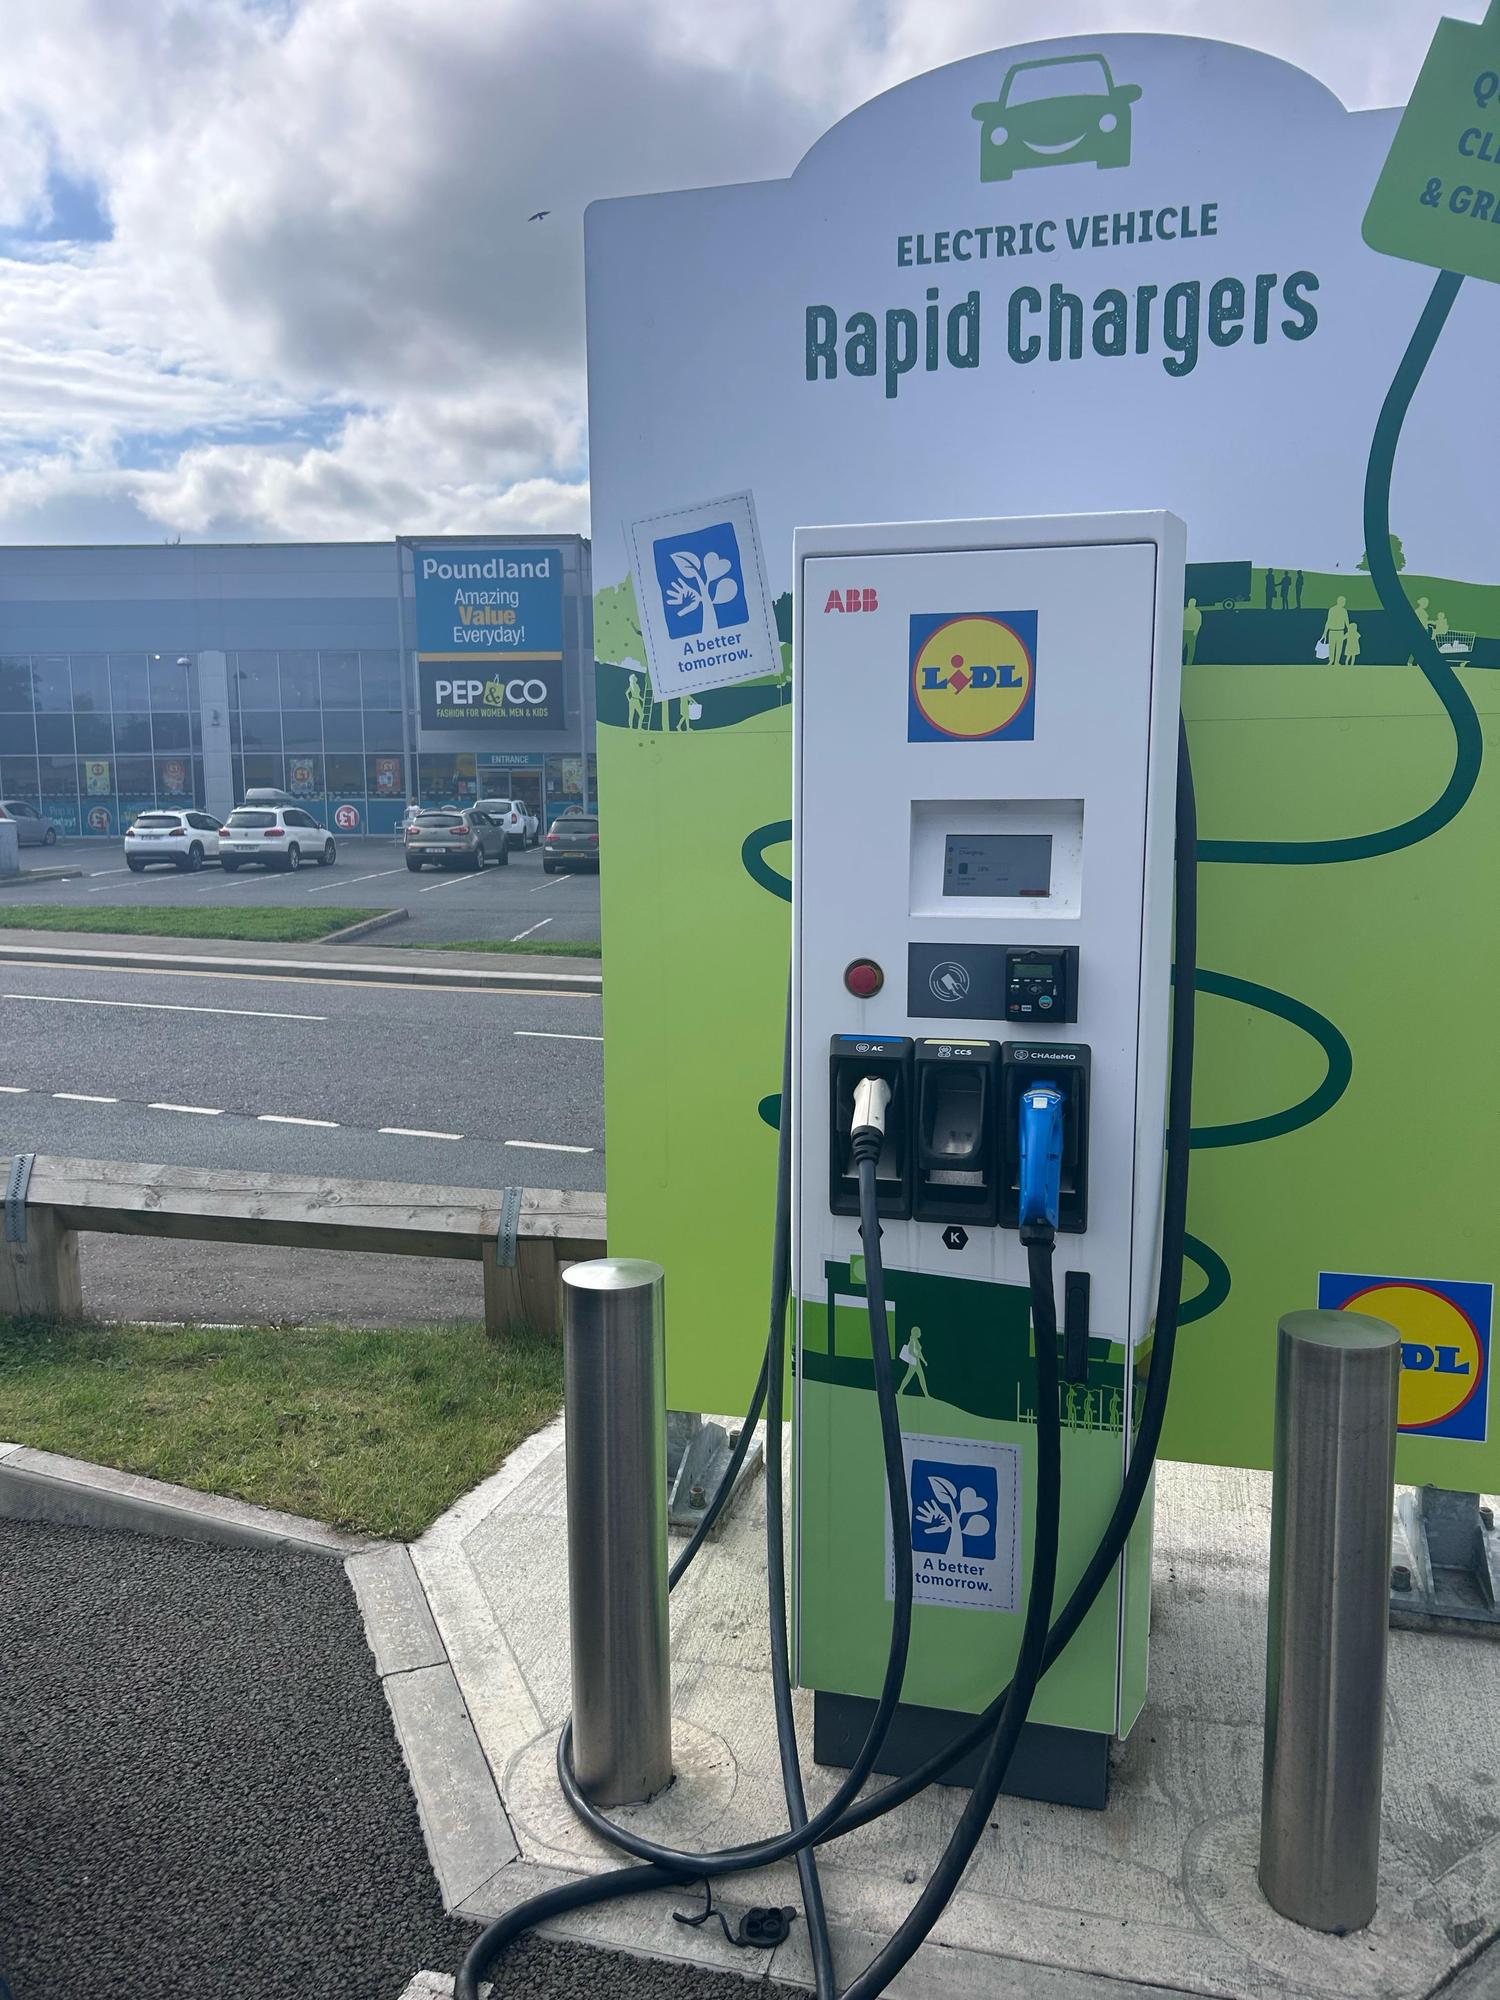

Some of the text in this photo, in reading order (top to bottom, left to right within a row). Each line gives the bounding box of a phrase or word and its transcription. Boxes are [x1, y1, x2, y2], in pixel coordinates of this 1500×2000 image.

[1473, 71, 1500, 109] Q
[1420, 177, 1443, 208] &
[897, 202, 1218, 267] ELECTRIC VEHICLE
[805, 270, 1320, 399] Rapid Chargers
[423, 557, 550, 580] Poundland
[454, 588, 519, 608] Amazing
[824, 588, 879, 613] ABB
[459, 606, 516, 625] Value
[453, 626, 526, 646] Everyday!
[683, 631, 742, 656] A better
[678, 648, 753, 673] tomorrow.
[436, 708, 464, 718] FASHION
[466, 708, 479, 717] FOR
[509, 708, 524, 717] MEN
[532, 708, 548, 717] KIDS
[491, 755, 528, 764] ENTRANCE
[338, 812, 355, 826] £1
[1031, 1052, 1076, 1061] CHAdeMO
[950, 1232, 960, 1243] K
[1401, 1342, 1470, 1375] DL
[923, 1558, 985, 1576] A better
[915, 1572, 993, 1592] tomorrow.
